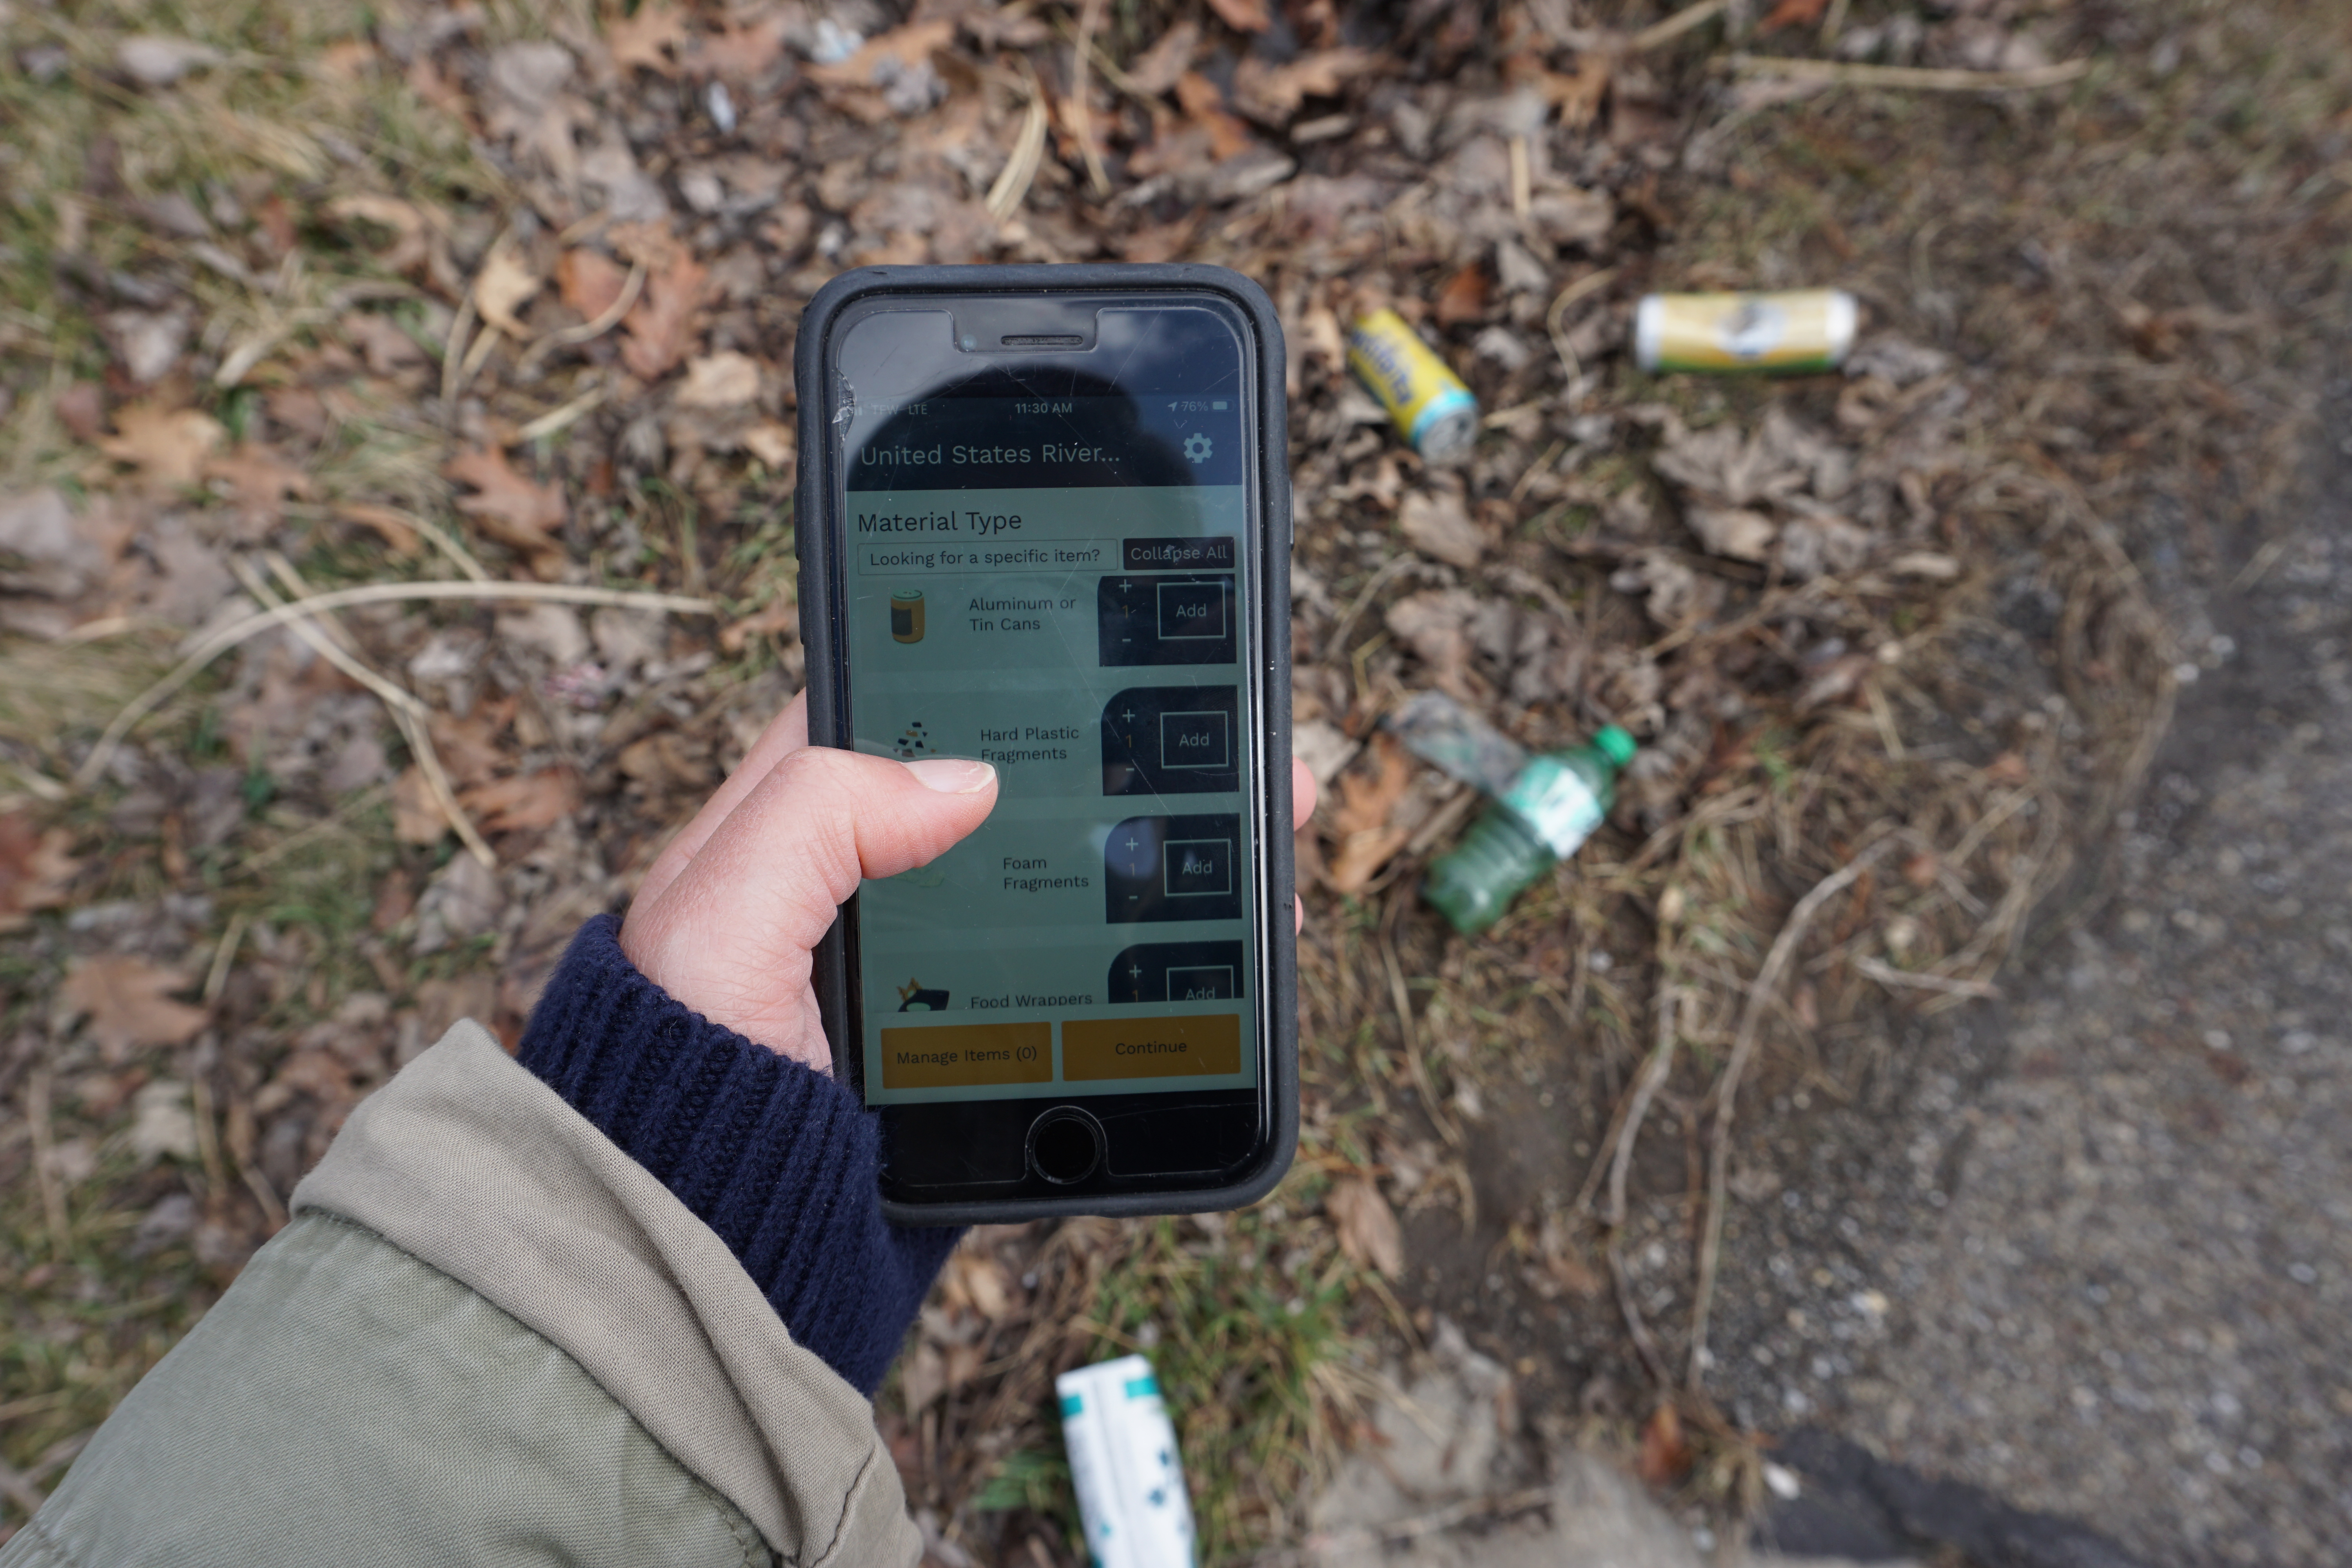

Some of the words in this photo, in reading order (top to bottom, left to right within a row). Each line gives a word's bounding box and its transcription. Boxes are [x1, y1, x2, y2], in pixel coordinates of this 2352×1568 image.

[909, 404, 927, 415] LTE
[1014, 403, 1048, 414] 11:30
[1052, 403, 1072, 413] AM
[1181, 401, 1209, 412] 76%
[862, 444, 941, 465] United
[952, 445, 1031, 464] States
[1043, 443, 1120, 463] River...
[858, 511, 958, 532] Material
[965, 512, 1022, 535] Type
[871, 552, 935, 568] Looking
[940, 551, 963, 564] for
[969, 554, 978, 564] a
[985, 549, 1048, 566] specific
[1054, 549, 1100, 562] item?
[1131, 547, 1200, 563] Collapse
[1206, 545, 1227, 559] All
[969, 597, 1053, 610] Aluminum
[1060, 598, 1076, 609] or
[1176, 603, 1207, 617] Add
[1122, 604, 1128, 619] 1
[969, 618, 994, 631] Tin
[1001, 617, 1041, 630] Cans
[980, 728, 1018, 742] Hard
[1025, 726, 1080, 740] Plastic
[1125, 734, 1132, 748] 1
[1179, 732, 1210, 746] Add
[981, 747, 1067, 764] Fragments
[1004, 857, 1047, 870] Foam
[1129, 862, 1135, 876] 1
[1182, 860, 1212, 875] Add
[1004, 875, 1089, 892] Fragments
[1185, 986, 1215, 1000] Add
[971, 995, 1009, 1009] Food
[1015, 993, 1092, 1006] Wrappers
[1115, 1041, 1187, 1055] Continue
[897, 1051, 958, 1066] Manage
[965, 1048, 1010, 1062] Items
[1016, 1045, 1037, 1061] (0)
